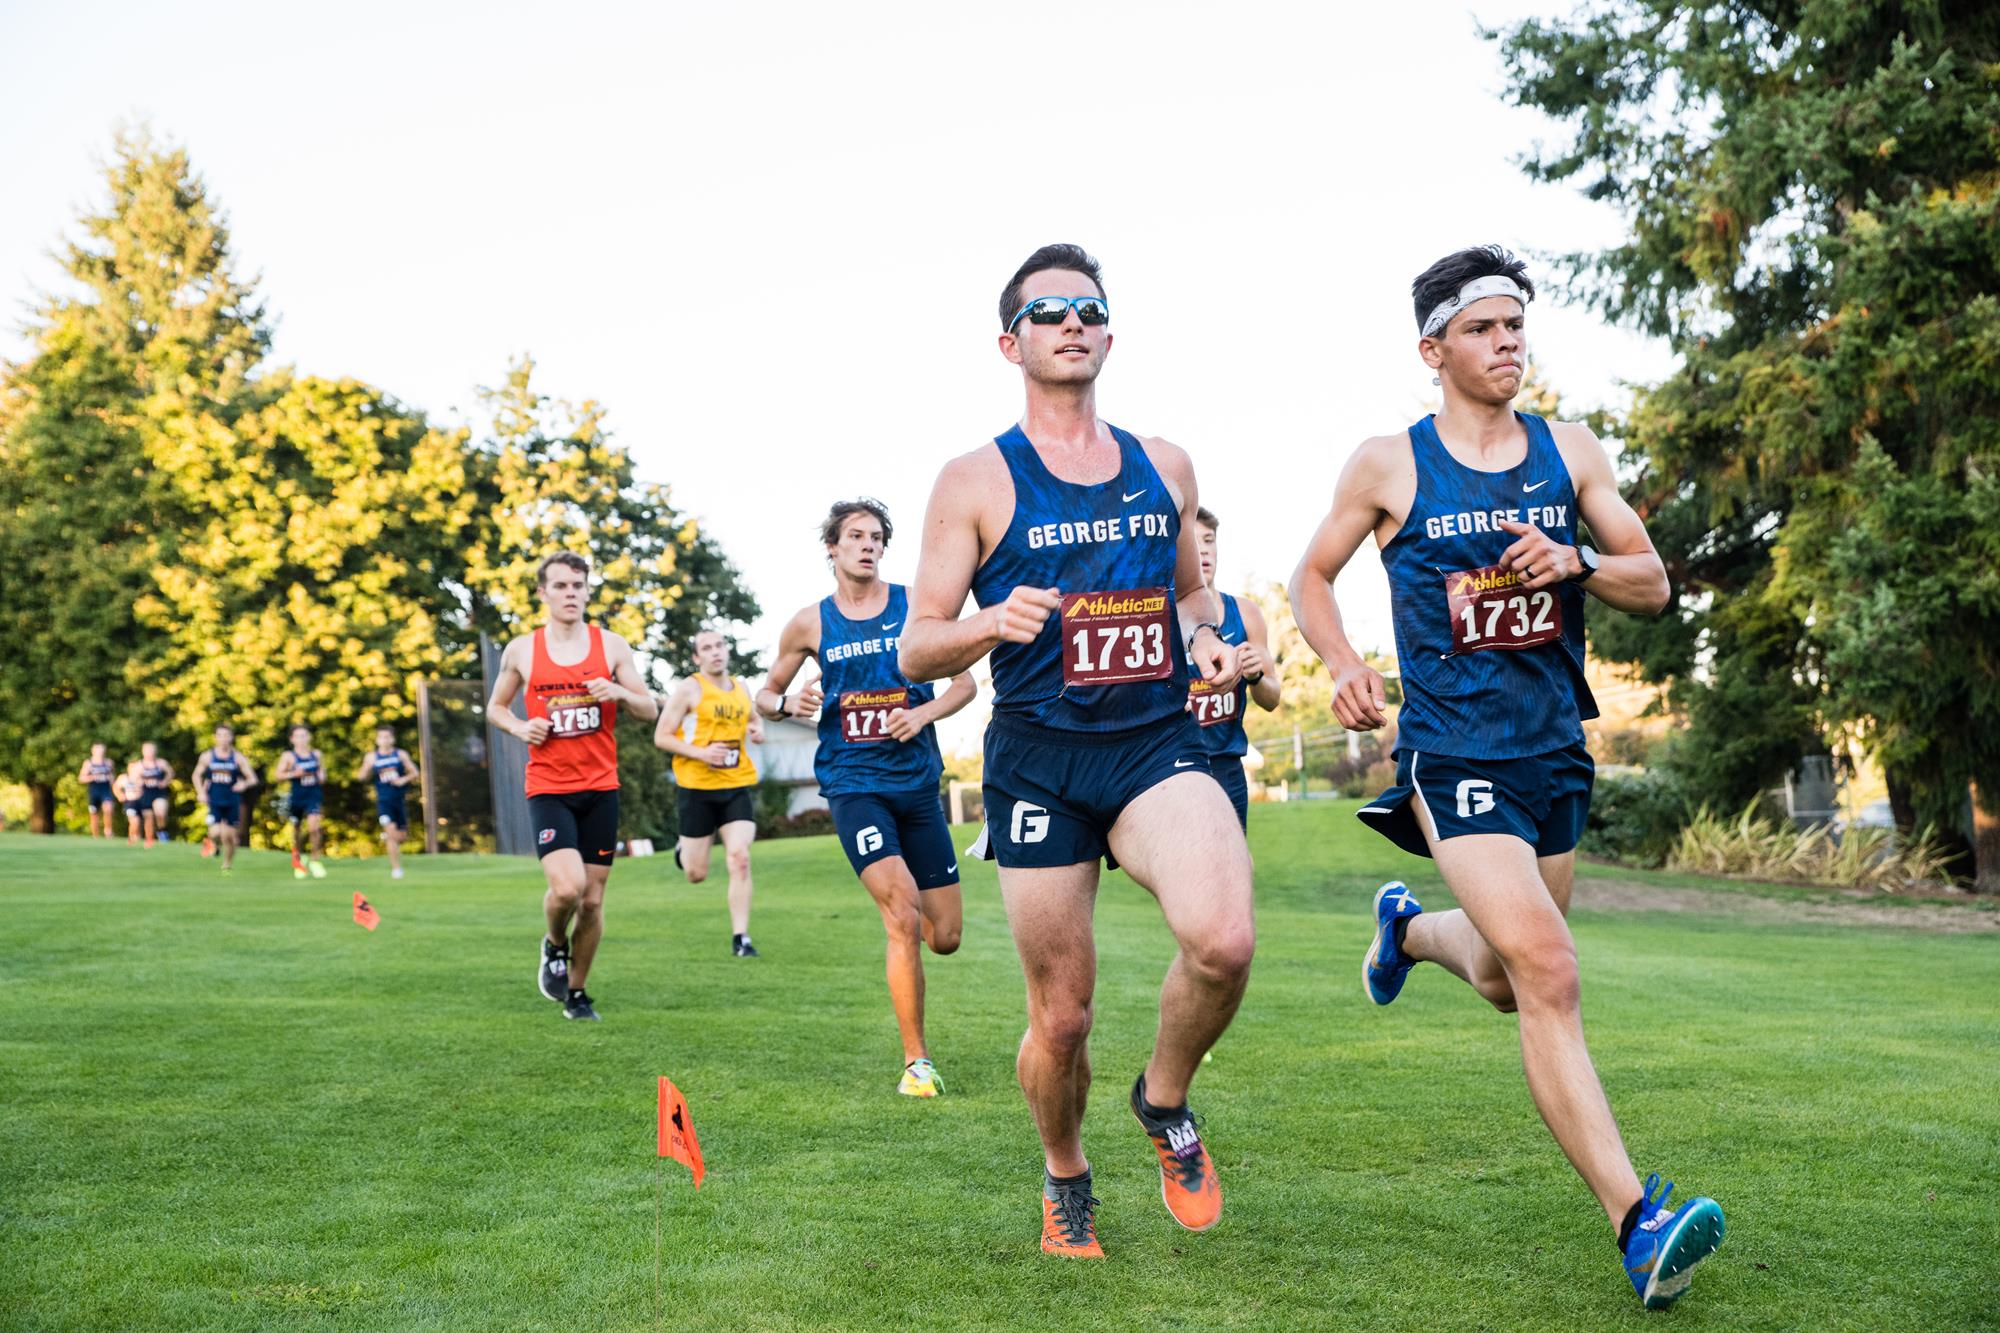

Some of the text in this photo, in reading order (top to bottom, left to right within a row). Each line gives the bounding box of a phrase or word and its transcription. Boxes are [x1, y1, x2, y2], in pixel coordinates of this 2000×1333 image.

[1527, 505, 1567, 529] FOX
[1027, 514, 1169, 550] GEORGE FOX
[1460, 591, 1555, 644] 1732
[826, 638, 883, 662] GEORGE
[1072, 623, 1164, 672] 1733
[551, 707, 600, 733] 1758
[1195, 691, 1235, 721] 730
[846, 708, 904, 737] 171
